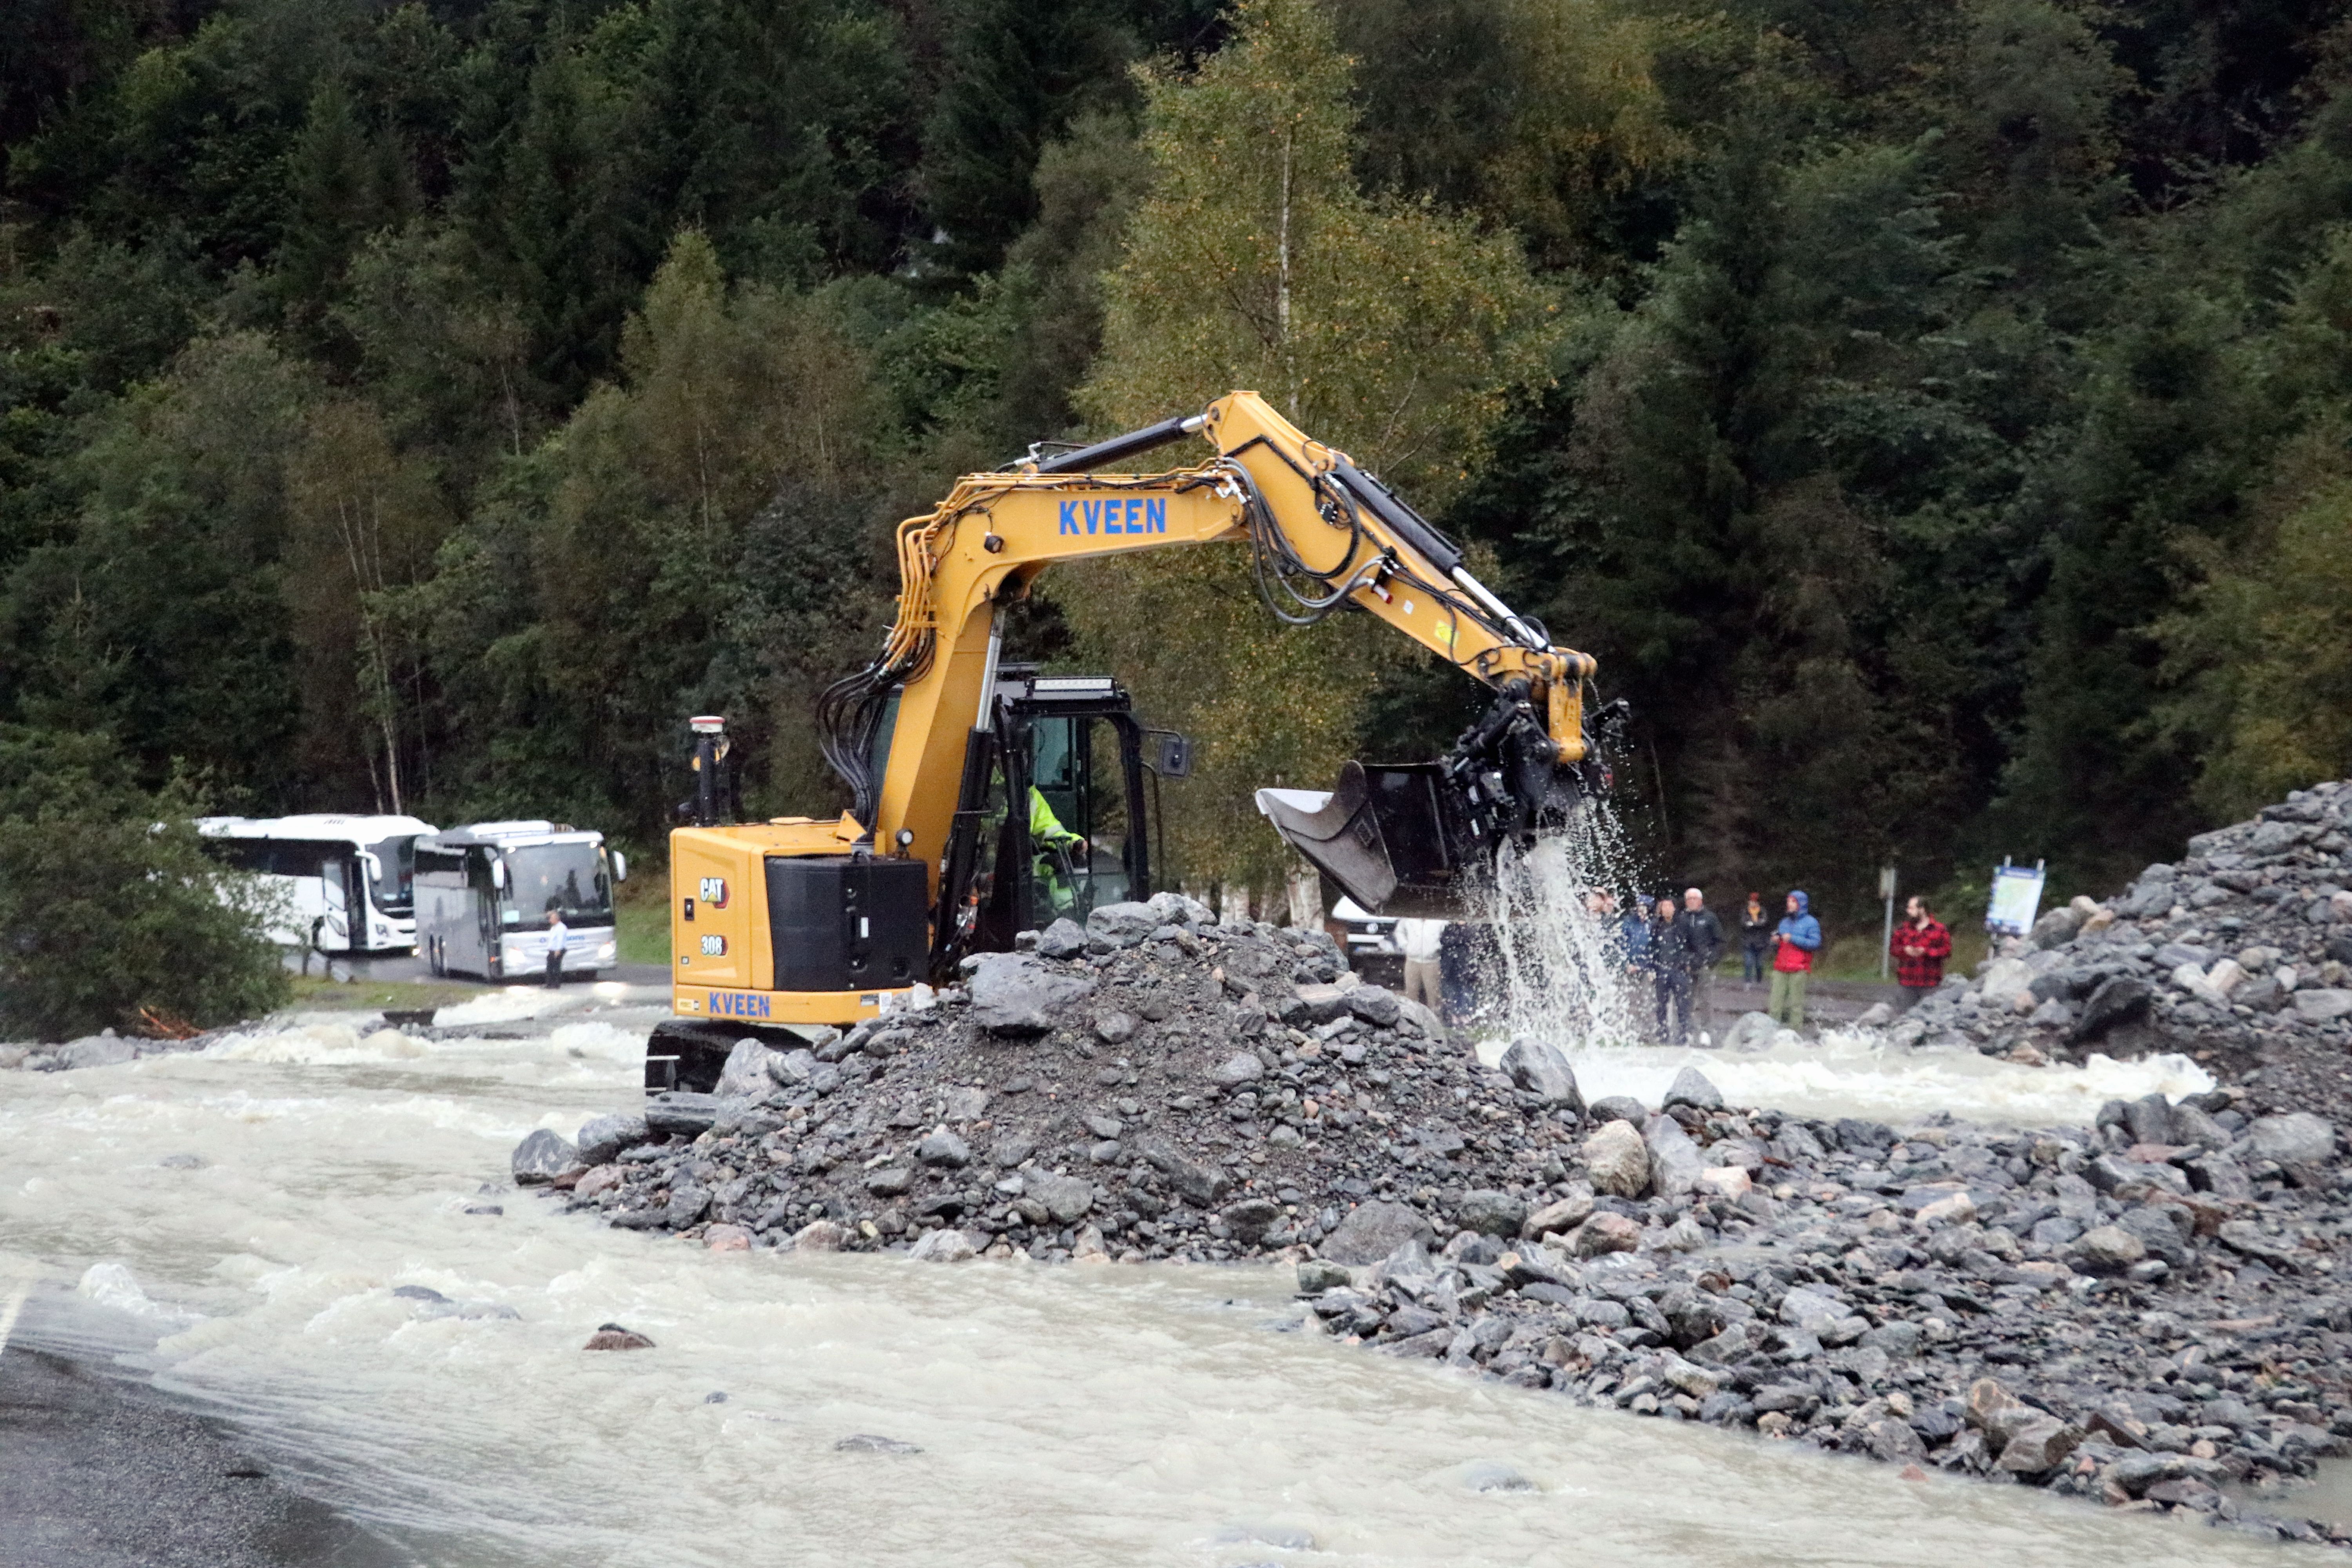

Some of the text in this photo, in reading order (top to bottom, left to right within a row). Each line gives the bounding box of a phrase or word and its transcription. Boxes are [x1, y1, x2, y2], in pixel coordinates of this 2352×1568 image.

[1060, 498, 1165, 535] KVEEN
[700, 878, 723, 902] CAT
[701, 935, 722, 955] 308
[709, 992, 769, 1017] KVEEN
